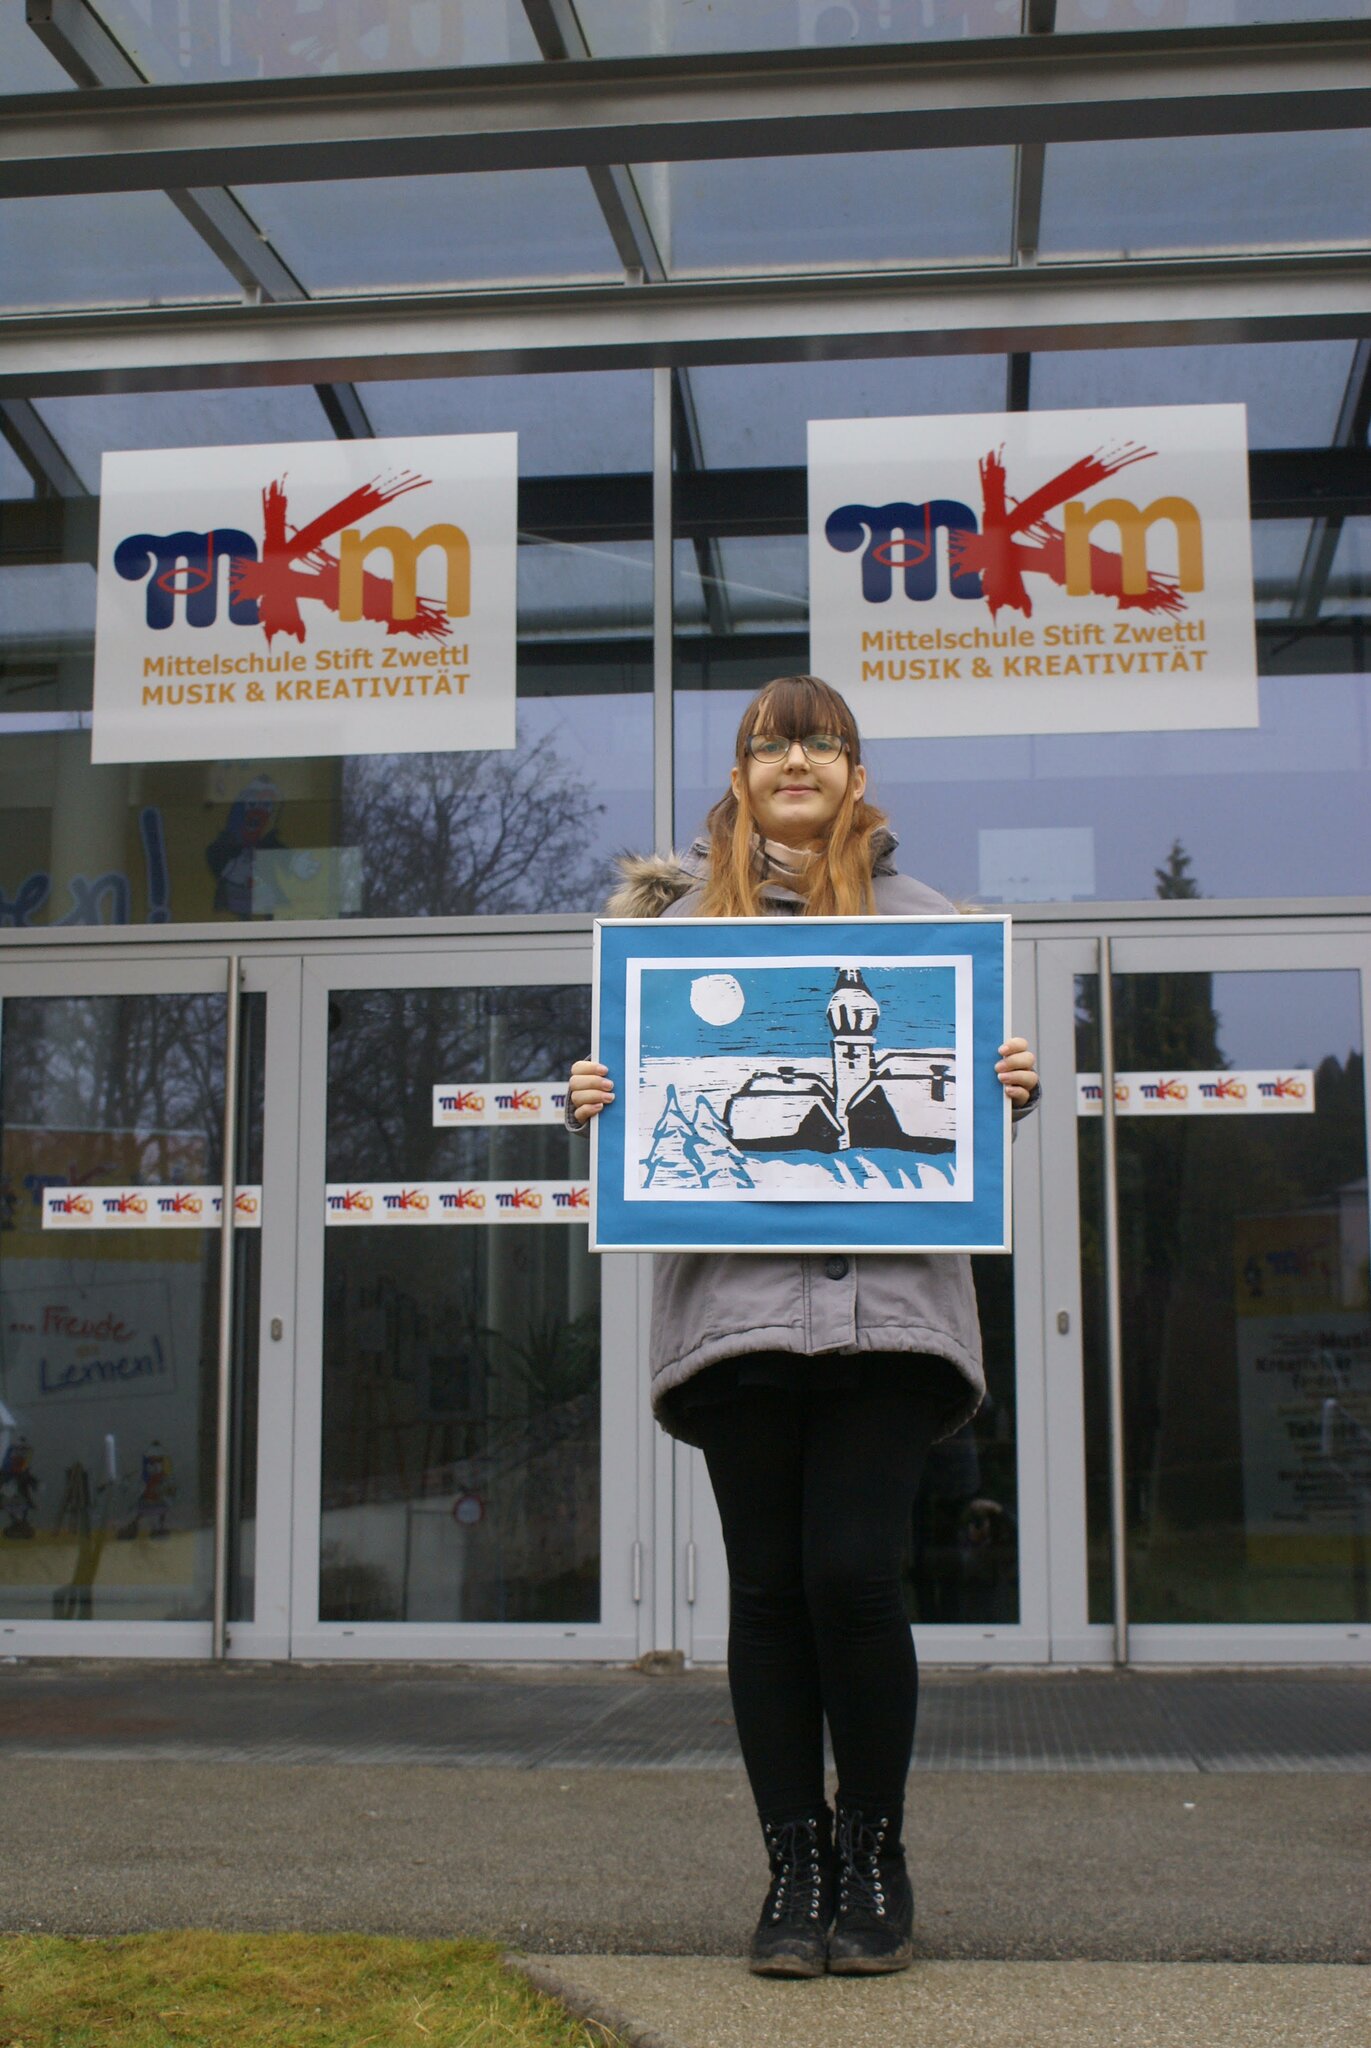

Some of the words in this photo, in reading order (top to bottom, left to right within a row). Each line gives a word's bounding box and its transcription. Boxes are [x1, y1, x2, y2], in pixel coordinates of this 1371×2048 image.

[861, 625, 1035, 652] Mittelschule
[1043, 623, 1105, 647] Stift
[1113, 619, 1205, 644] Zwettl
[143, 651, 307, 677] Mittelschule
[315, 648, 373, 670] Stift
[381, 644, 469, 668] Zwettl
[862, 658, 961, 682] MUSIK
[971, 656, 993, 679] &
[1003, 645, 1208, 677] KREATIVITÄT
[142, 682, 236, 706] MUSIK
[246, 681, 265, 702] &
[276, 669, 470, 701] KREATIVITÄT
